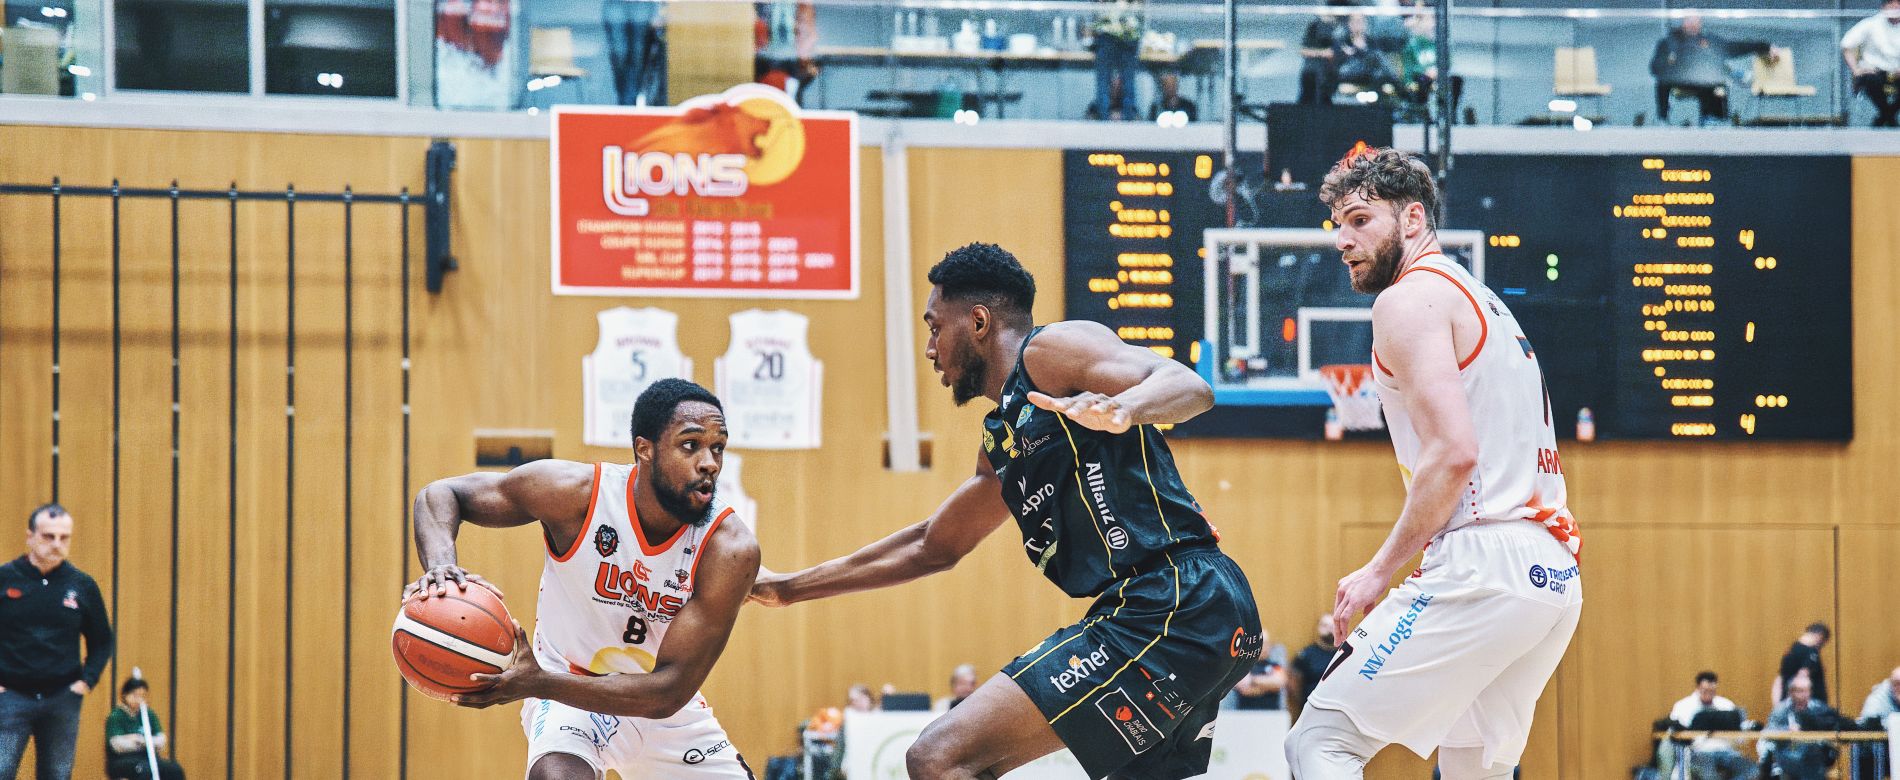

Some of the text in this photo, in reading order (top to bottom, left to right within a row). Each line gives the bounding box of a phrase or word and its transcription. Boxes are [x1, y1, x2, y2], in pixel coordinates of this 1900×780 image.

[603, 146, 748, 216] LIONS
[631, 350, 646, 381] 5
[753, 352, 784, 381] 20
[1086, 462, 1115, 525] Allianz
[595, 562, 684, 617] LIONS
[623, 615, 648, 644] 8
[1050, 644, 1109, 693] texner
